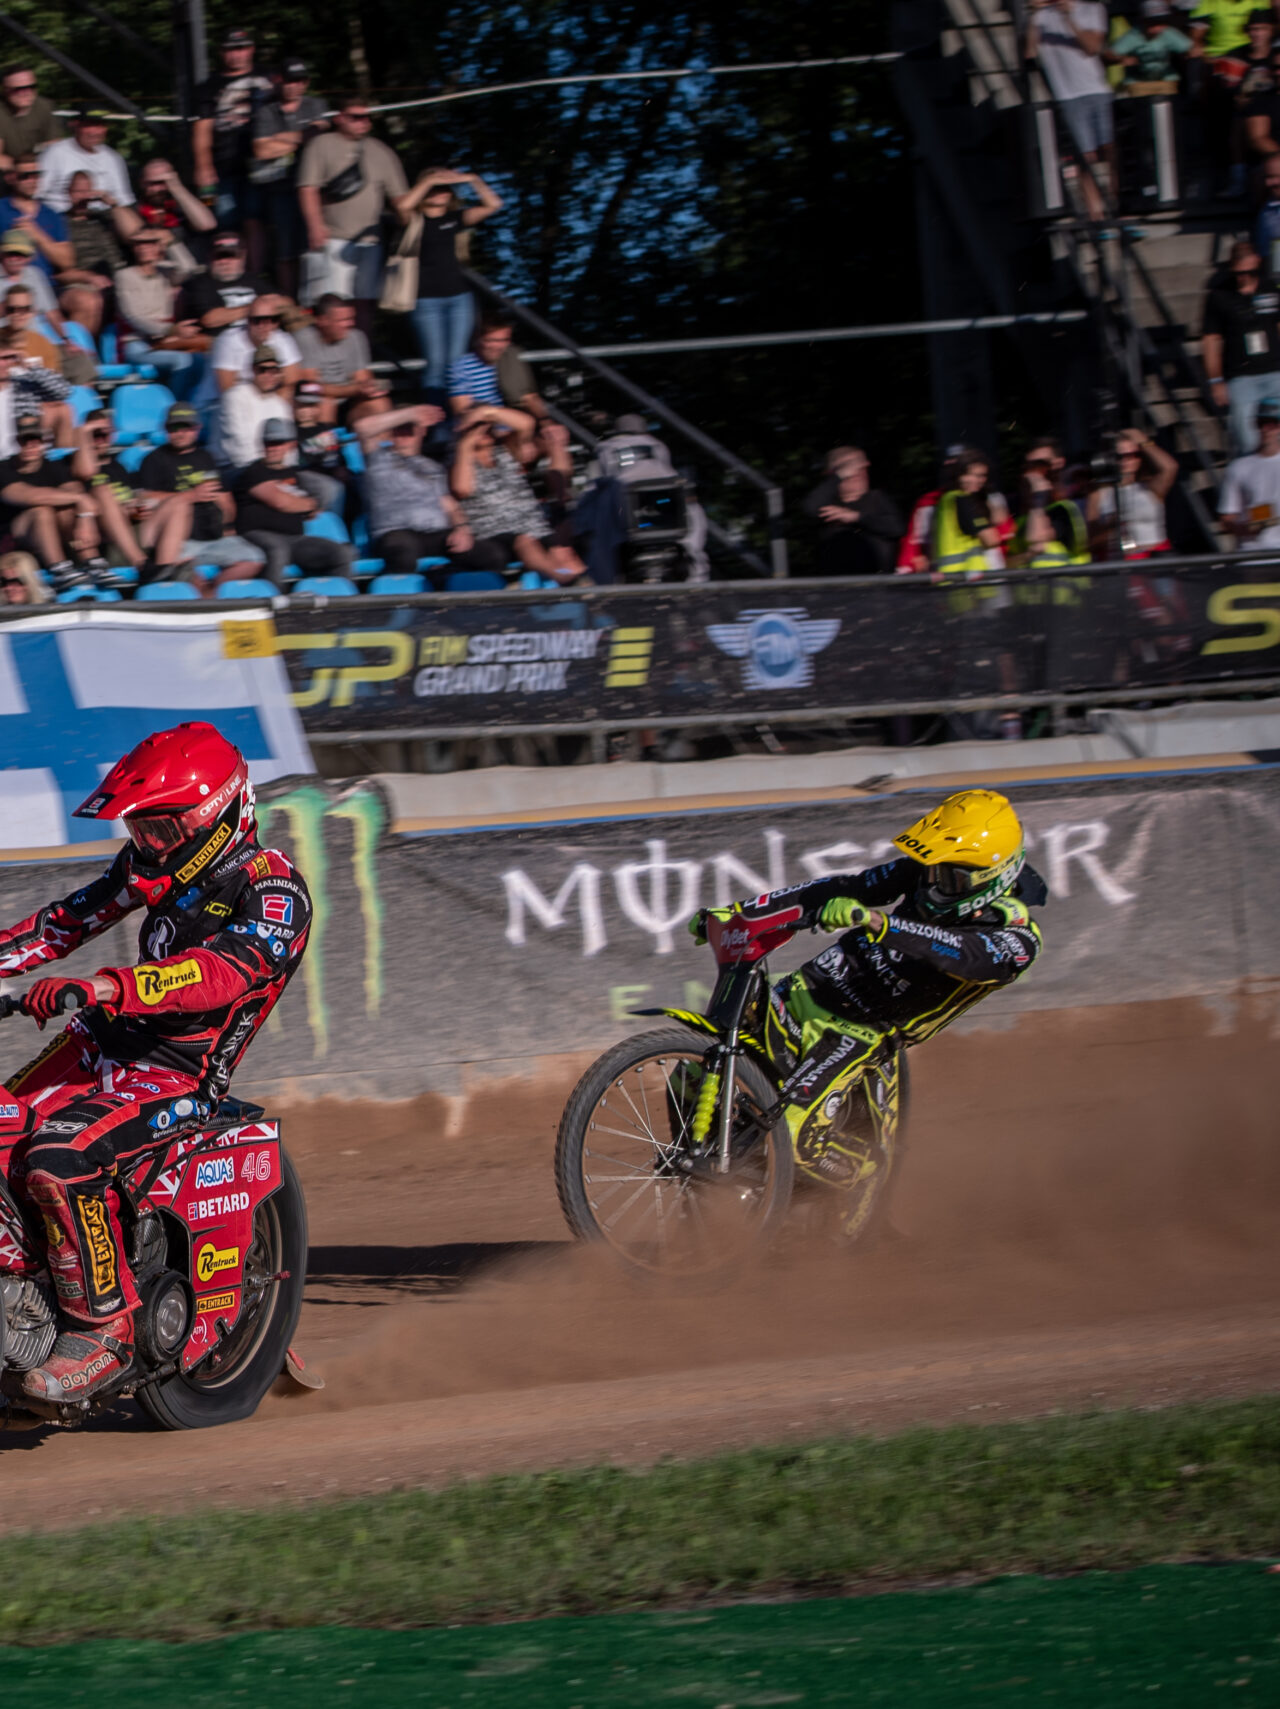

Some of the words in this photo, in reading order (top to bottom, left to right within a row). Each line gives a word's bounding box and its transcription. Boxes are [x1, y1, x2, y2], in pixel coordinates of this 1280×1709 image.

[466, 629, 604, 664] SPEEDWAY
[414, 666, 507, 697] GRAND
[505, 661, 571, 692] PRIX
[199, 796, 224, 817] OPTY
[226, 774, 242, 797] LINE
[195, 828, 228, 867] ENTRACK
[896, 834, 934, 860] BOLL
[502, 820, 1136, 956] MONR
[957, 884, 1004, 917] BOLL
[248, 919, 295, 940] ETARD
[796, 1035, 857, 1087] DYNAMAX
[197, 1159, 228, 1184] AQUA
[242, 1151, 271, 1182] 46
[199, 1192, 250, 1219] BETARD
[201, 1251, 237, 1274] Rentruck
[207, 1294, 232, 1309] ENTRACK
